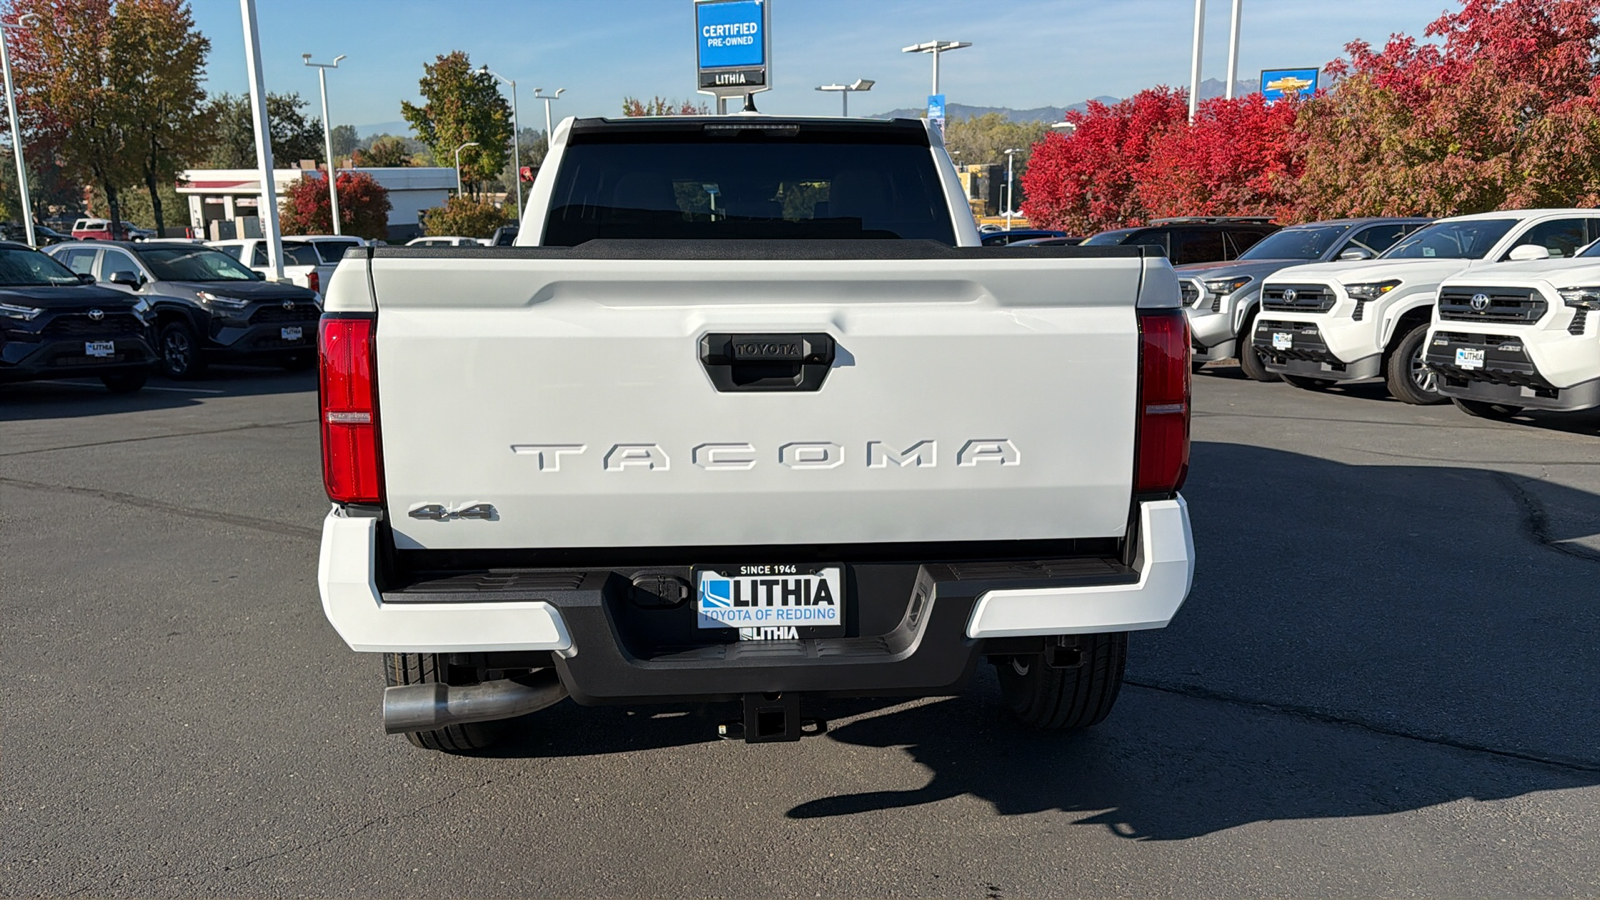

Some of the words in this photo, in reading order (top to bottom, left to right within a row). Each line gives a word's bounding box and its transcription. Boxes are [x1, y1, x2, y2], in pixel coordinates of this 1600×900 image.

[703, 22, 758, 37] CERTIFIED
[707, 36, 754, 47] PRE-OWNED
[715, 73, 746, 85] LITHIA
[735, 343, 800, 356] TOYOTA
[1463, 350, 1484, 361] LITHIA
[510, 438, 1022, 473] TACOMA
[740, 565, 771, 575] SINCE
[774, 565, 797, 574] 1946
[733, 578, 835, 607] LITHIA
[702, 609, 750, 621] TOYOTA
[756, 609, 773, 621] OF
[776, 608, 836, 620] REDDING
[752, 627, 799, 640] LITHIA
